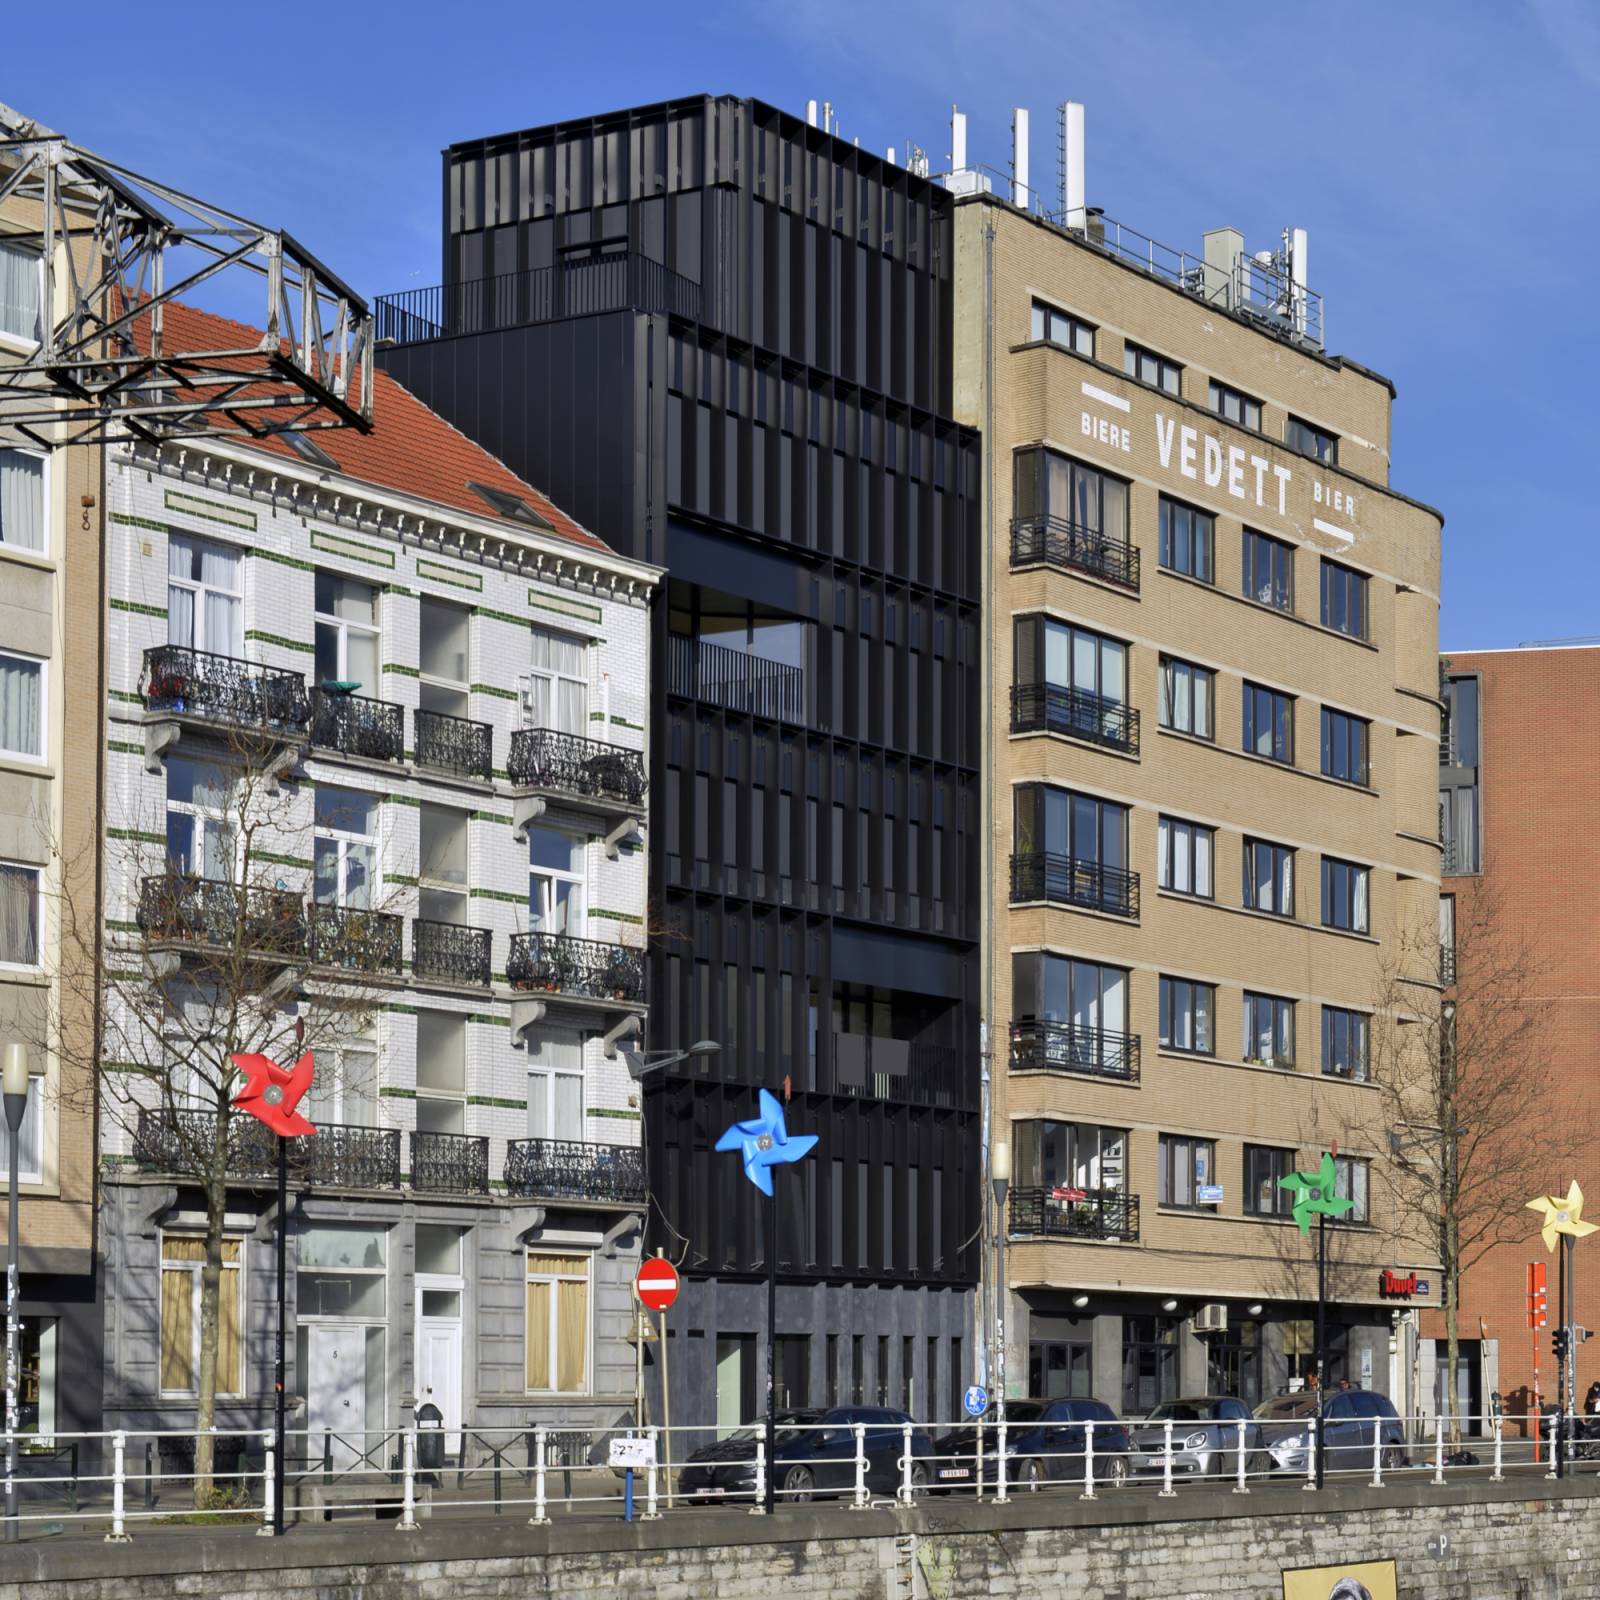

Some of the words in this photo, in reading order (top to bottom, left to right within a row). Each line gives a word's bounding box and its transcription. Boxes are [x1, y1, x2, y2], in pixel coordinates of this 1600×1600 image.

[1081, 411, 1131, 453] BIERE
[1155, 413, 1292, 516] VEDETT
[1313, 481, 1354, 517] BIER
[1382, 1269, 1417, 1296] Duvel
[1439, 1534, 1448, 1556] P
